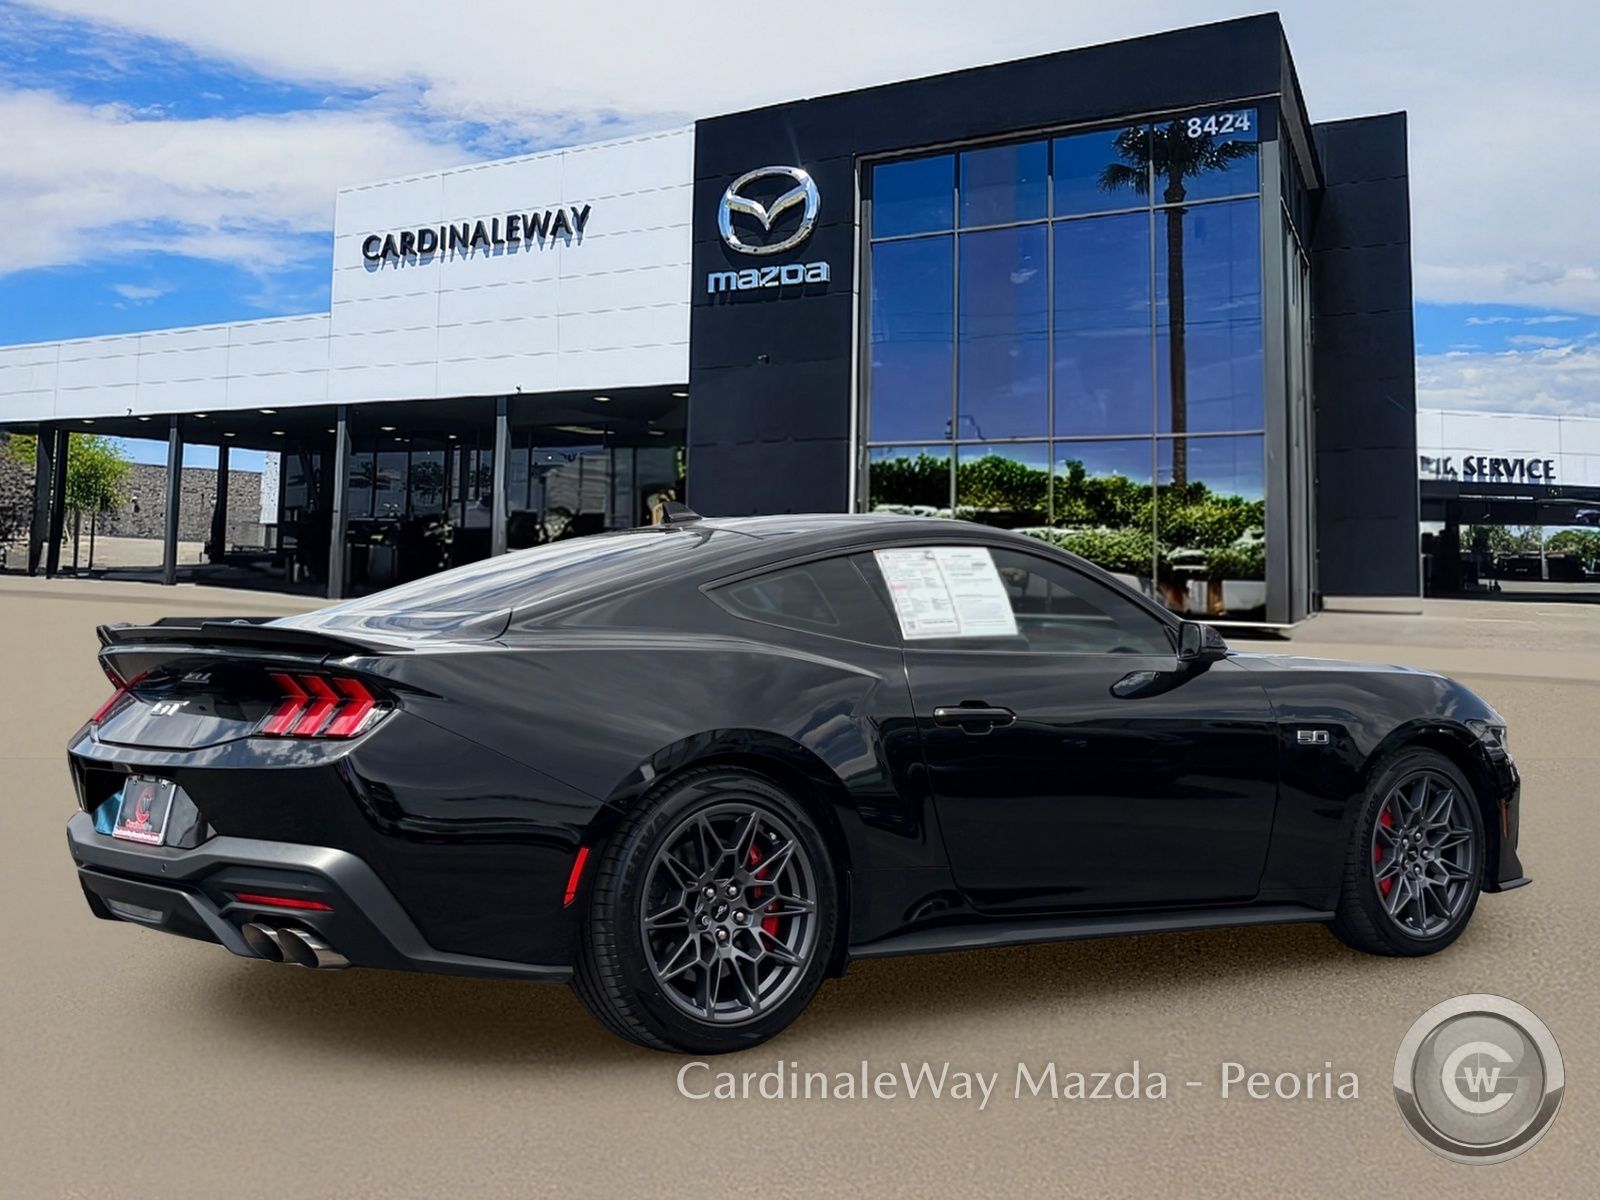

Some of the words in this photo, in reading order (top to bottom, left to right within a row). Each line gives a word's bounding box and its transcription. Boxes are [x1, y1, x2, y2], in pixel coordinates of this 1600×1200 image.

[1187, 112, 1251, 138] 8424
[362, 204, 592, 261] CARDINALEWAY
[707, 261, 830, 293] mazda
[1462, 455, 1556, 480] SERVICE
